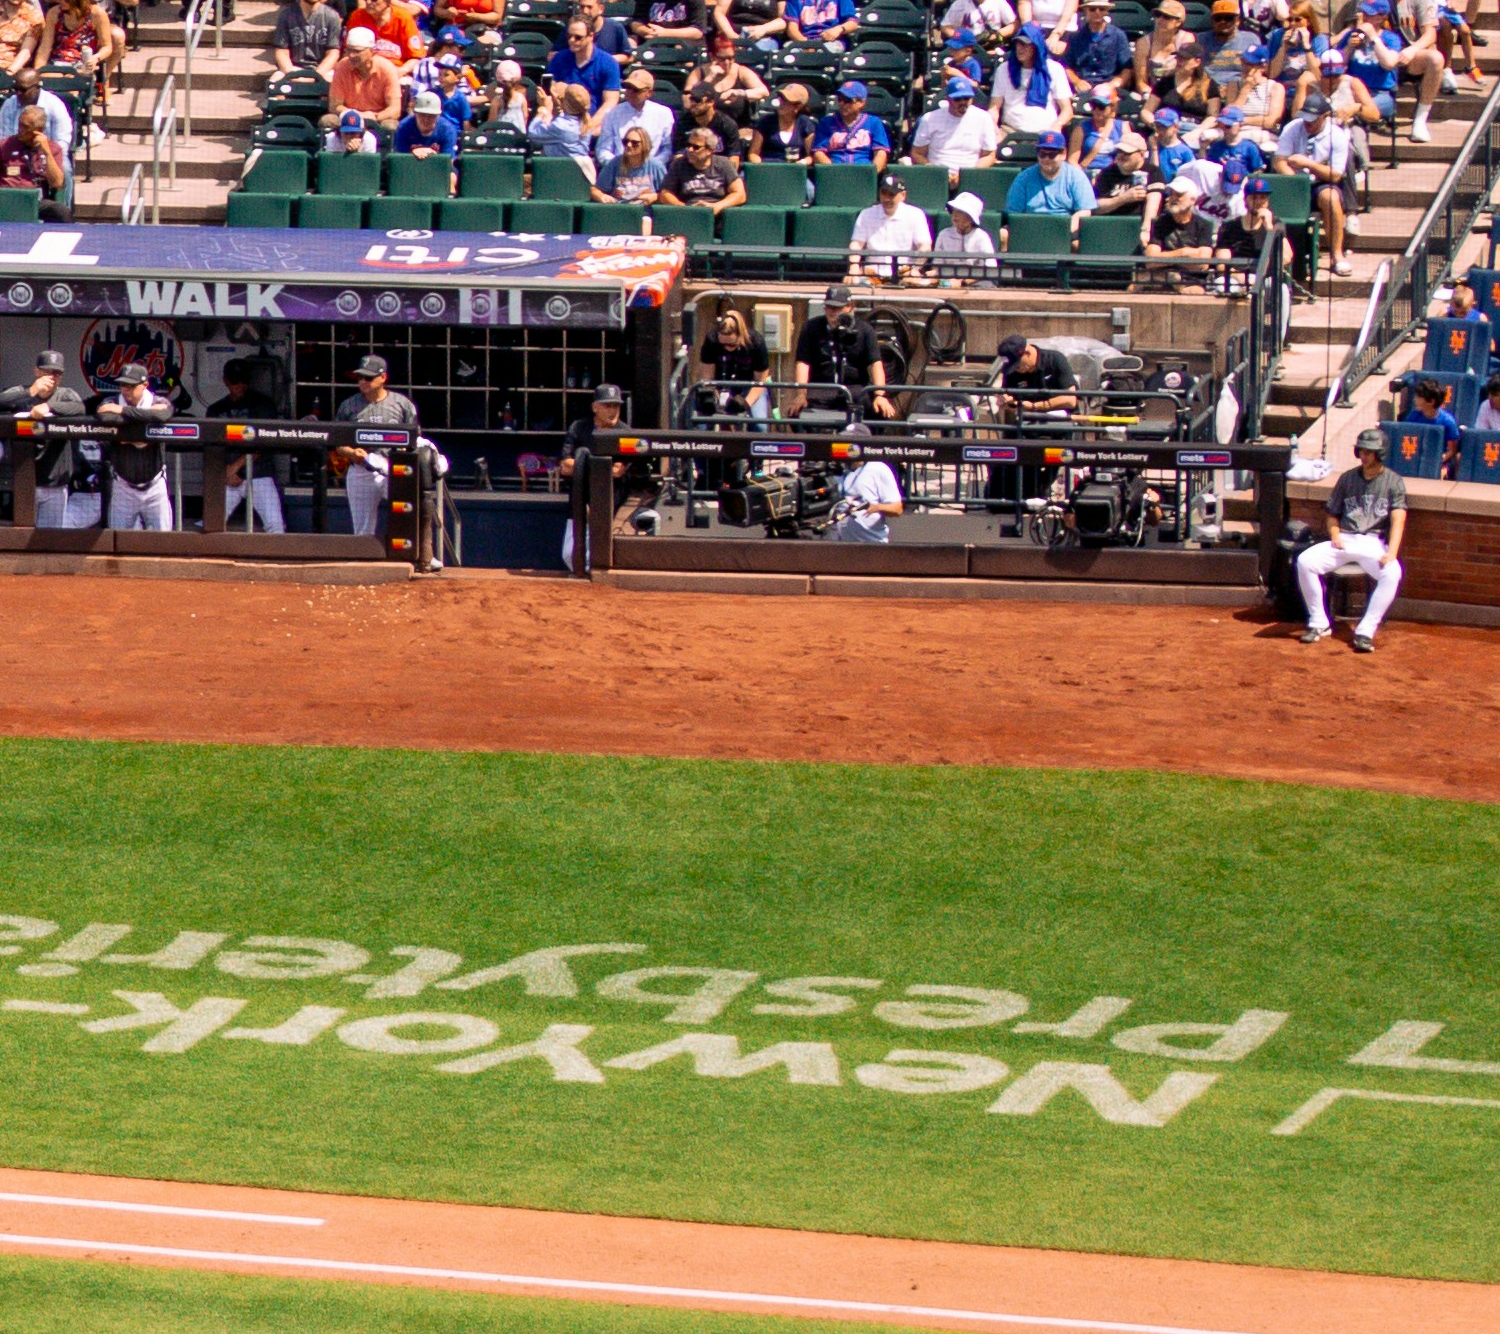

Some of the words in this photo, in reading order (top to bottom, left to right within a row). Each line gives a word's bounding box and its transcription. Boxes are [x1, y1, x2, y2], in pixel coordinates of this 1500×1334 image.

[126, 280, 286, 317] WALK
[48, 424, 67, 432] New
[88, 426, 117, 434] Lottery
[258, 429, 277, 437] New
[278, 429, 297, 437] York
[298, 430, 328, 440] Lottery
[692, 443, 722, 451] Lottery
[904, 448, 934, 457] Lottery
[1118, 453, 1148, 461] Lottery
[1346, 495, 1389, 519] NYC
[2, 991, 1220, 1128] NewYork-
